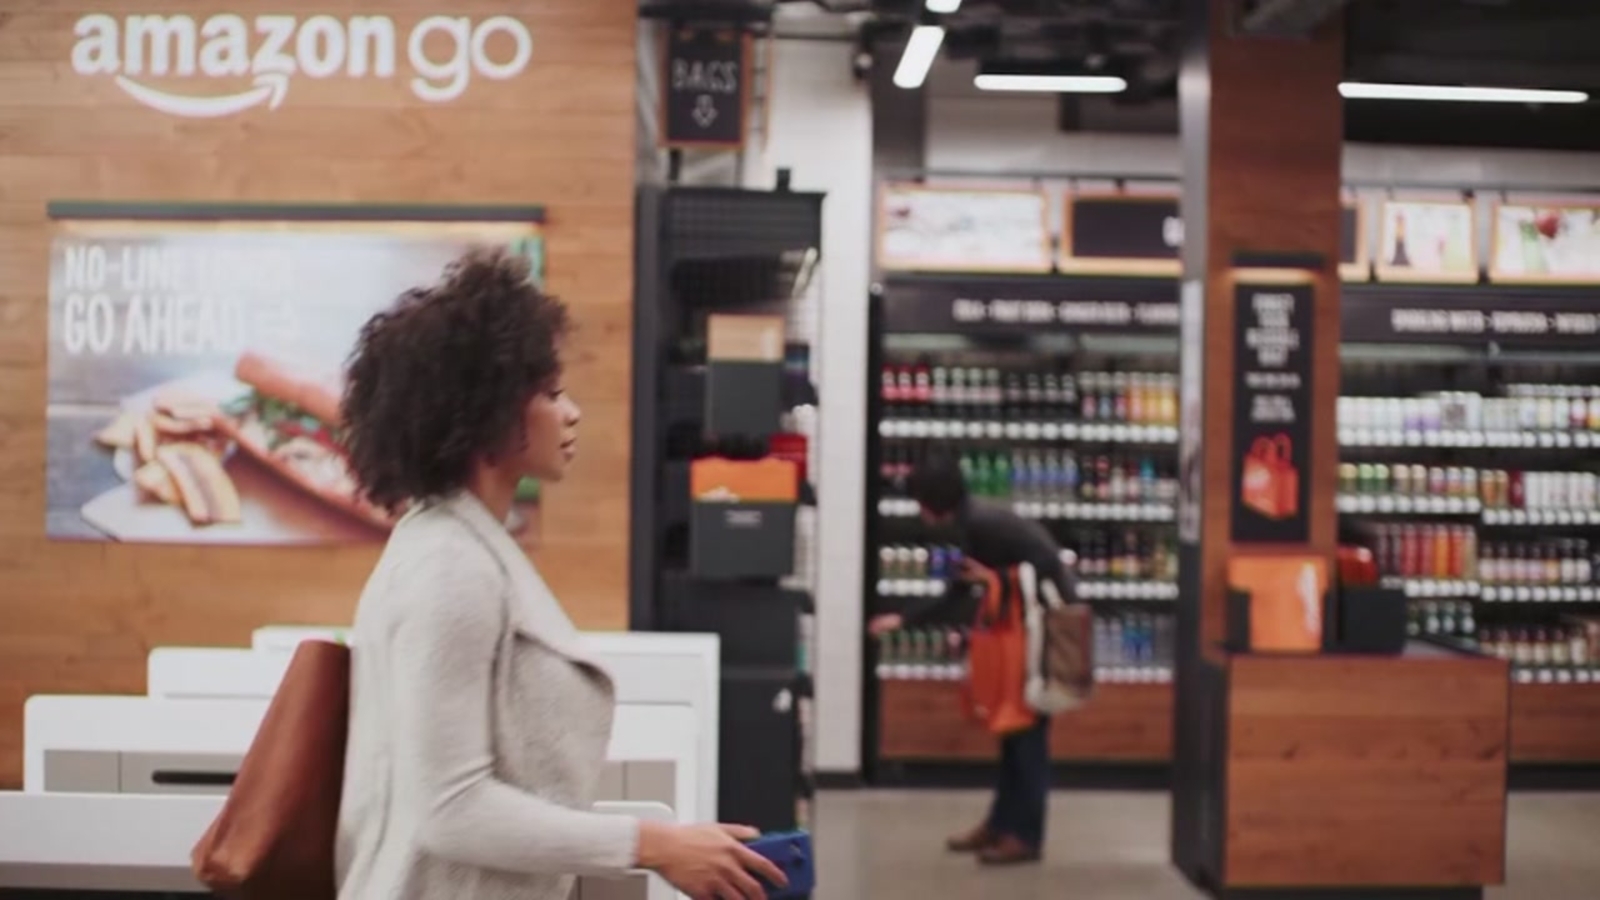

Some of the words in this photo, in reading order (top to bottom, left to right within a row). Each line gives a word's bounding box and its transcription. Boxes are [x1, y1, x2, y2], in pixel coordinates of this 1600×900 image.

[72, 13, 396, 79] amazon
[408, 14, 533, 103] go
[64, 294, 115, 355] GO
[122, 294, 245, 355] AHEAD
